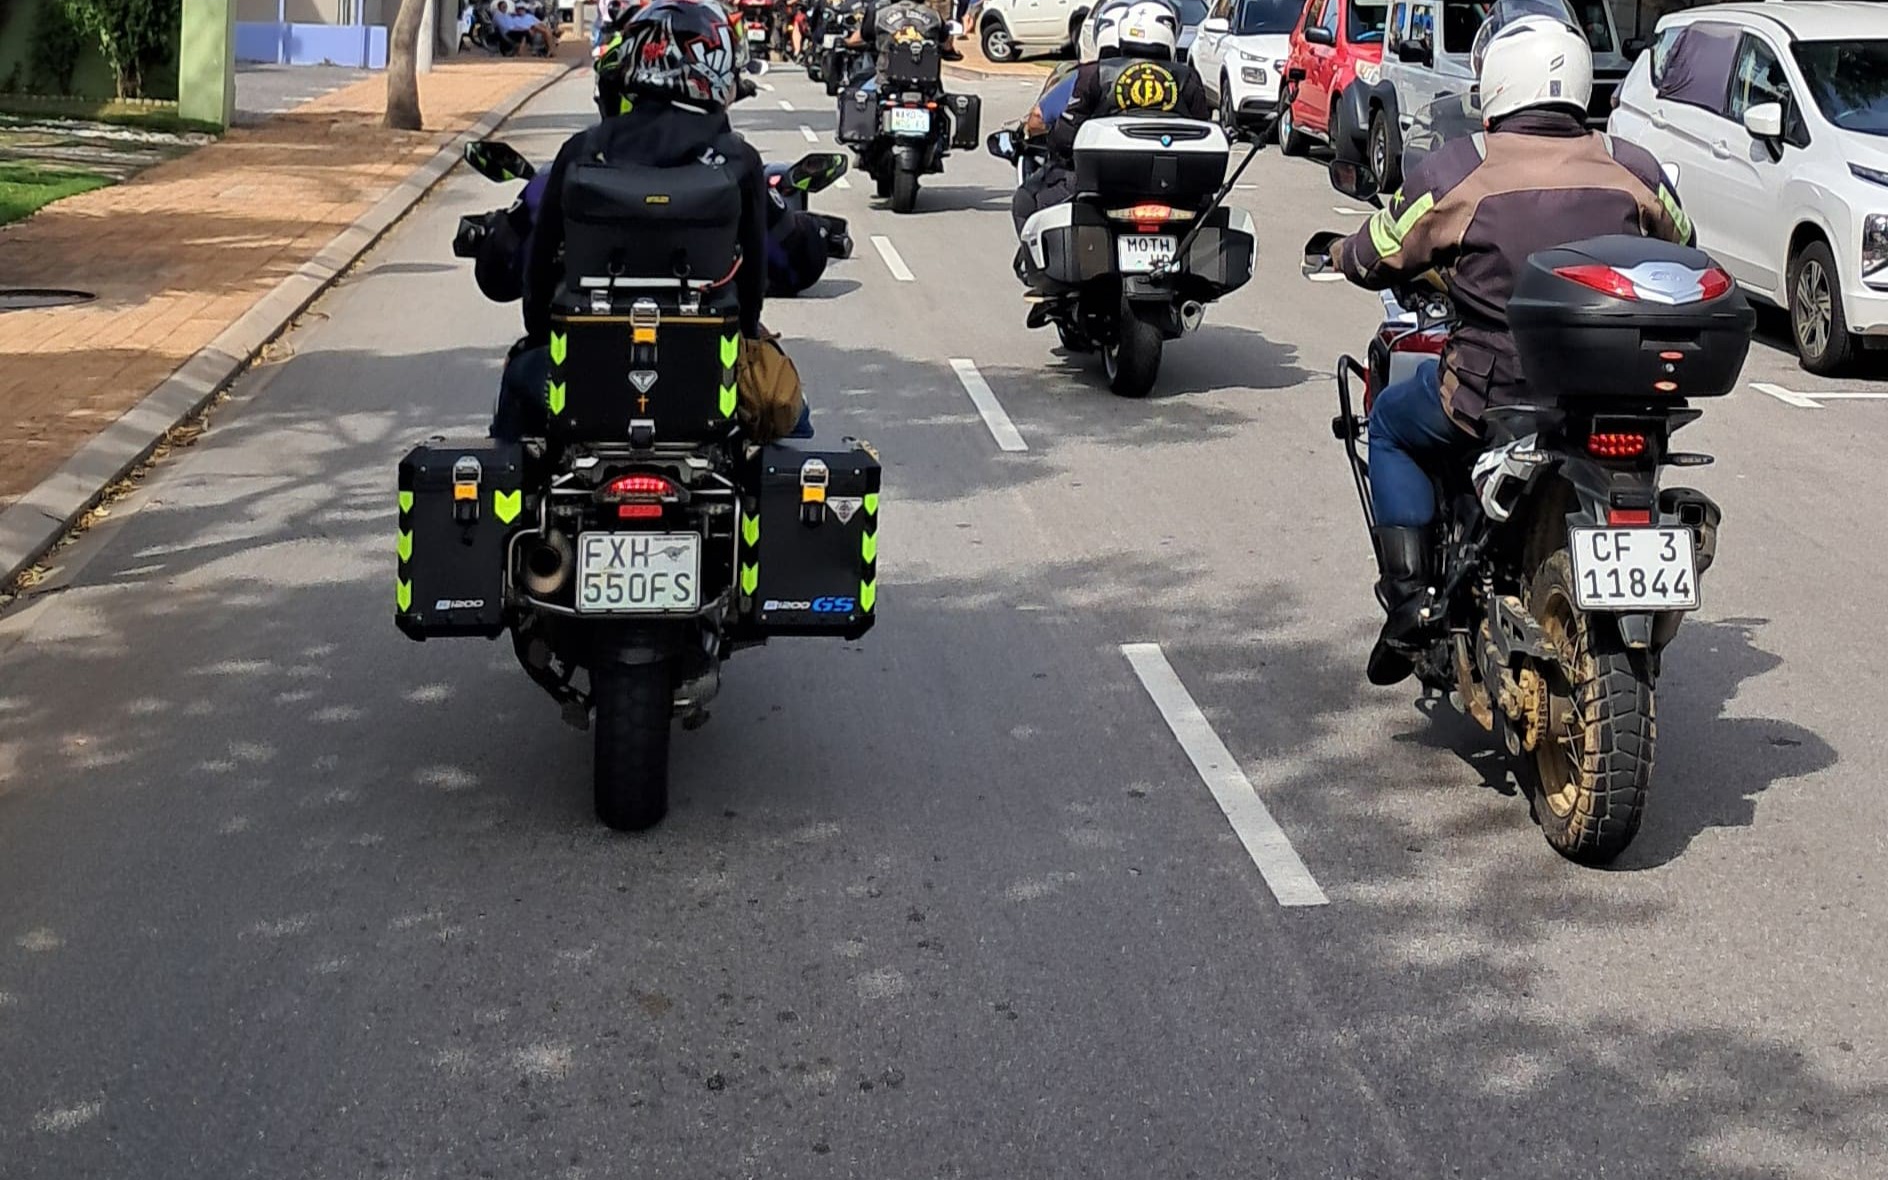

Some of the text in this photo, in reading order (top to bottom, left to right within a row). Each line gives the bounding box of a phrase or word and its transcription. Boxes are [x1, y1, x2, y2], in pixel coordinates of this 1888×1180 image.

[1126, 237, 1170, 252] MOTH
[585, 538, 650, 568] FXH
[1591, 531, 1678, 562] CF 3
[583, 572, 691, 604] 550FS
[1583, 568, 1691, 599] 11844
[812, 597, 856, 612] GS
